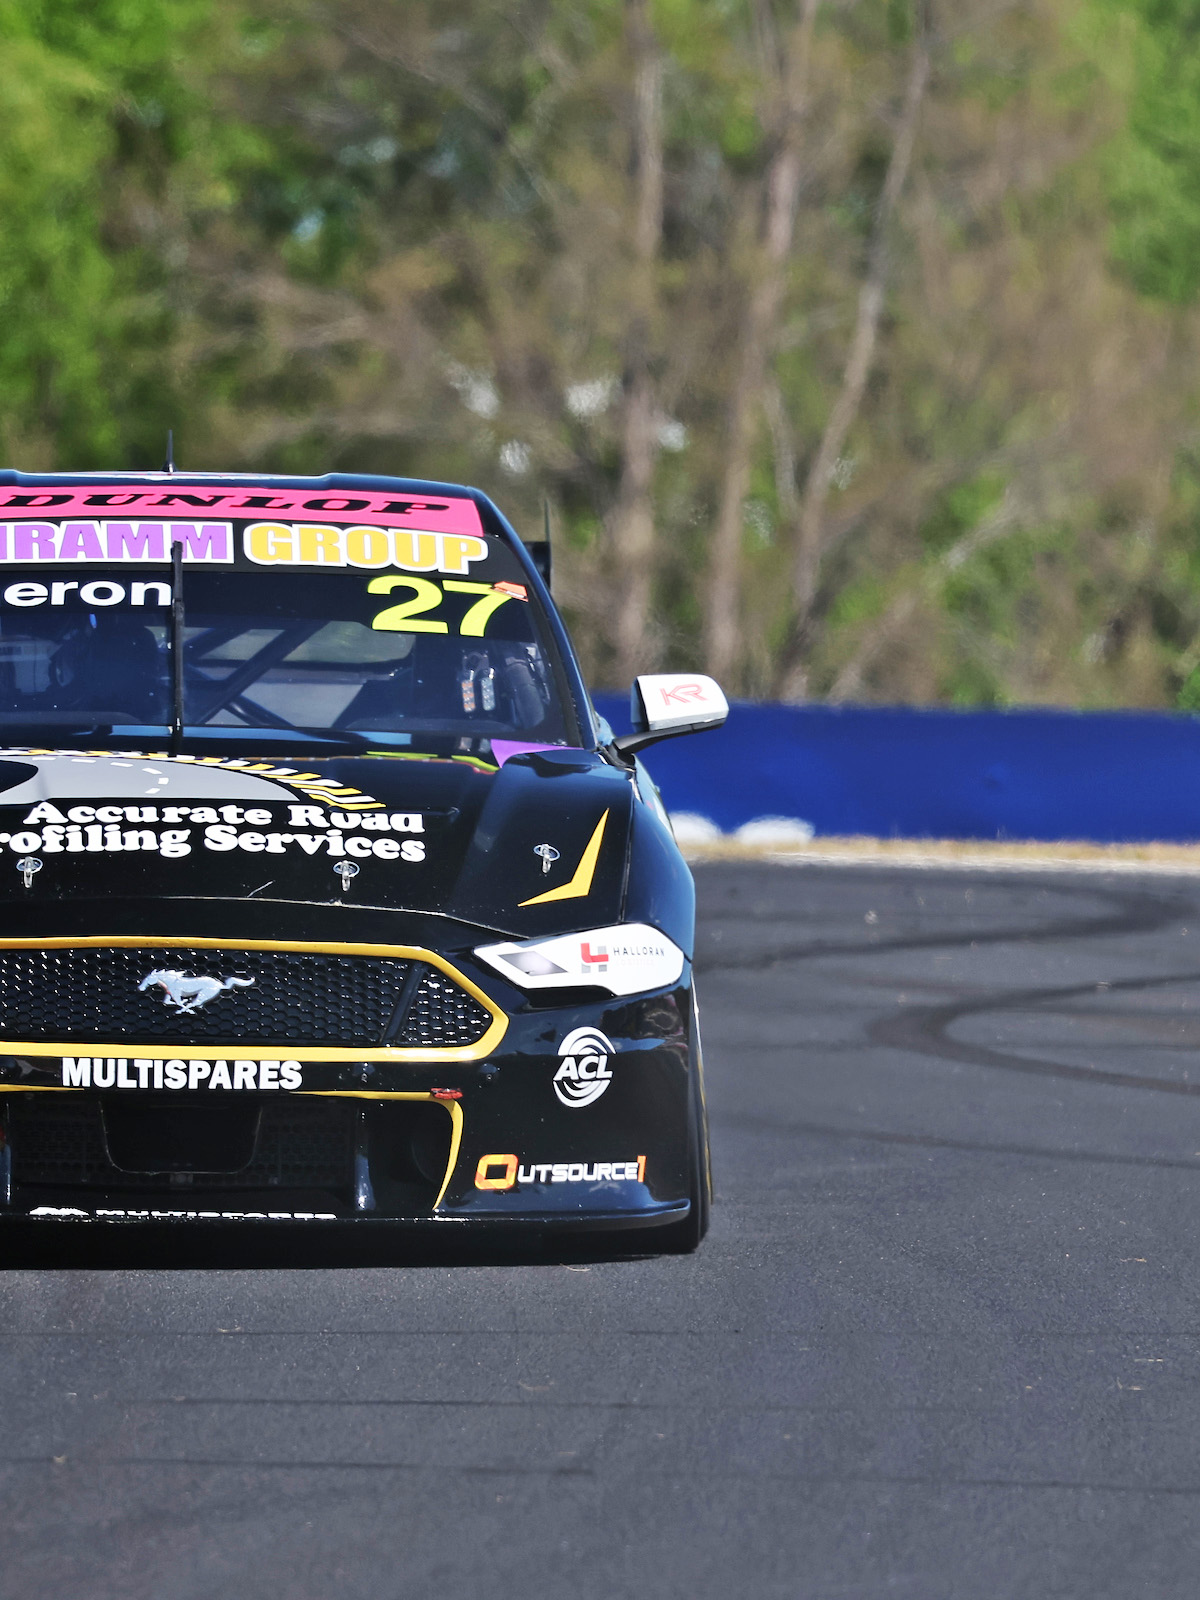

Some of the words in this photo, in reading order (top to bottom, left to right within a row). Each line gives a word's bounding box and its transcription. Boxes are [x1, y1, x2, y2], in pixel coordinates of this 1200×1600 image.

[243, 522, 489, 574] GROUP
[367, 575, 512, 637] 27
[659, 683, 709, 706] KR
[23, 802, 273, 826] Accurate
[287, 804, 426, 834] Road
[204, 825, 426, 863] Services
[613, 945, 665, 957] HALLORAN
[62, 1056, 302, 1091] MULTISPARES
[553, 1054, 613, 1081] ACL
